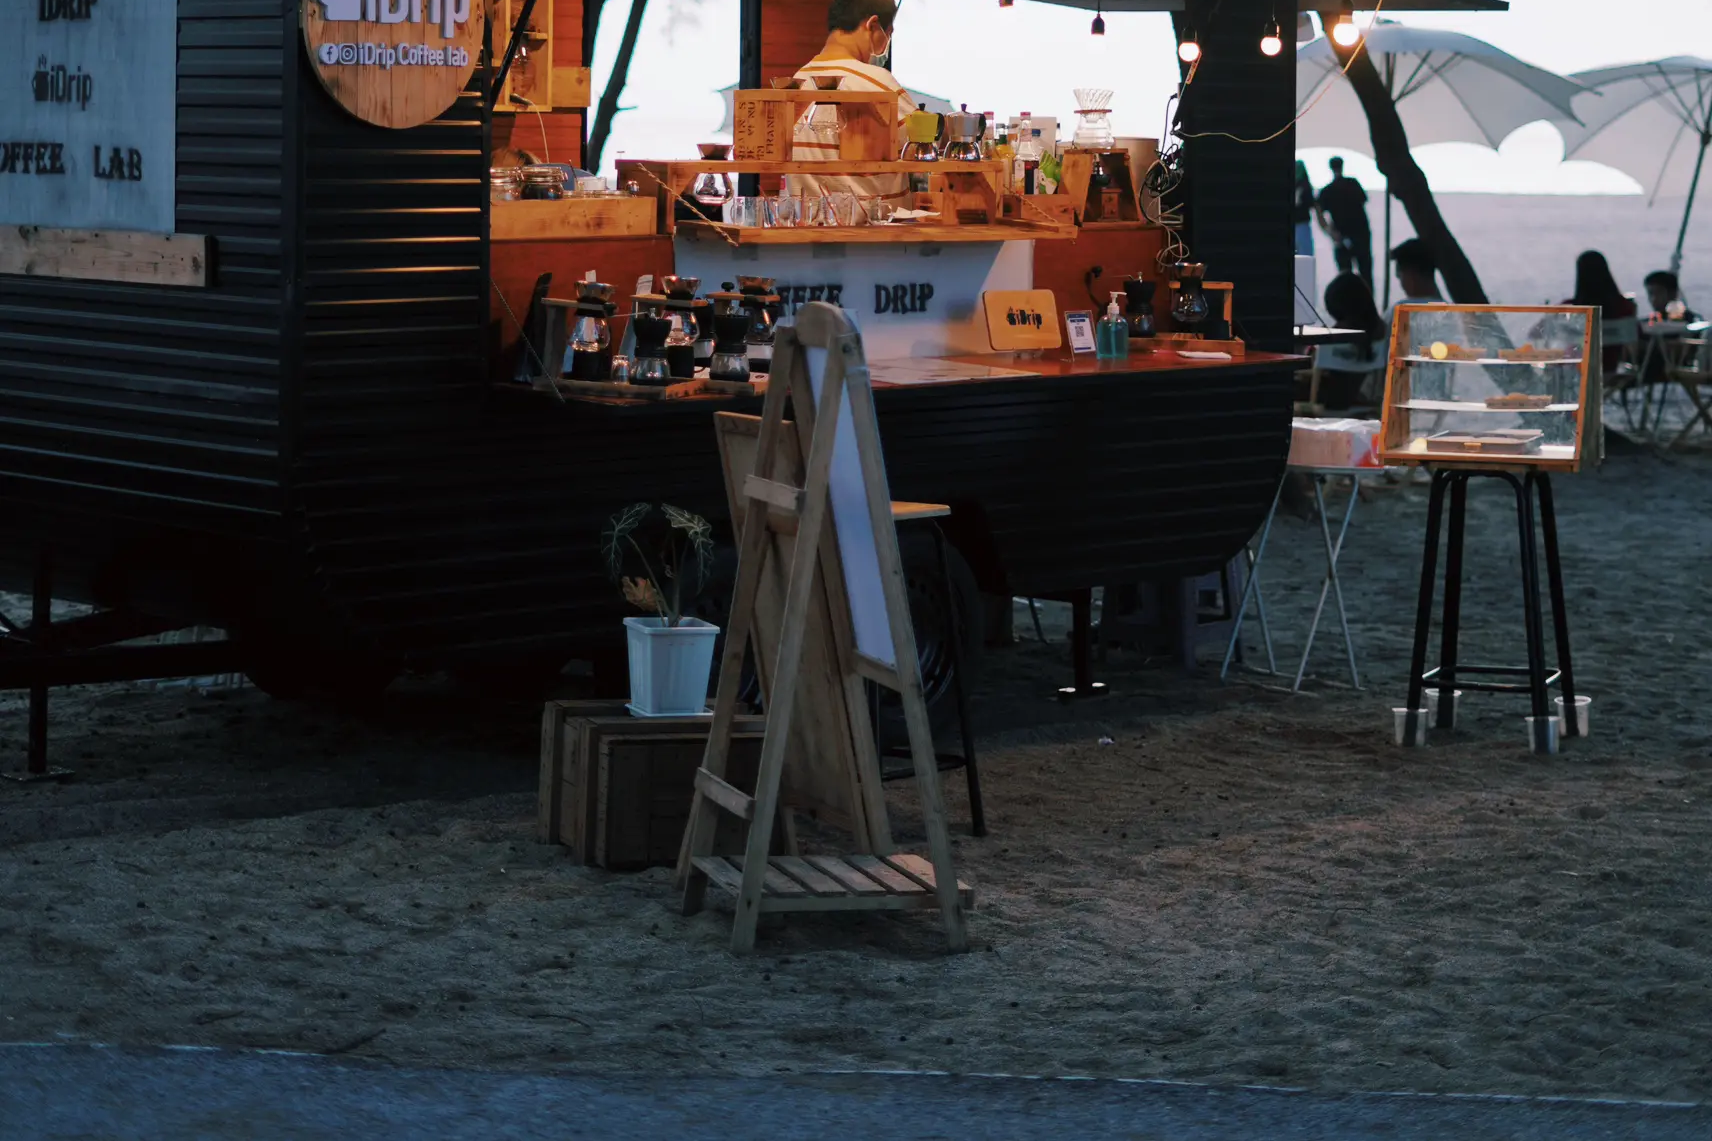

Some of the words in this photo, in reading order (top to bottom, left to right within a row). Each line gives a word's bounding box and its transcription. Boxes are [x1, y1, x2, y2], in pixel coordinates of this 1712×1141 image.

[358, 42, 396, 69] iDrip
[398, 43, 444, 65] Coffee
[447, 46, 468, 67] lab
[50, 64, 92, 111] iDrip
[93, 144, 142, 181] LAB
[874, 282, 934, 315] DRIP
[1016, 308, 1043, 330] iDrip
